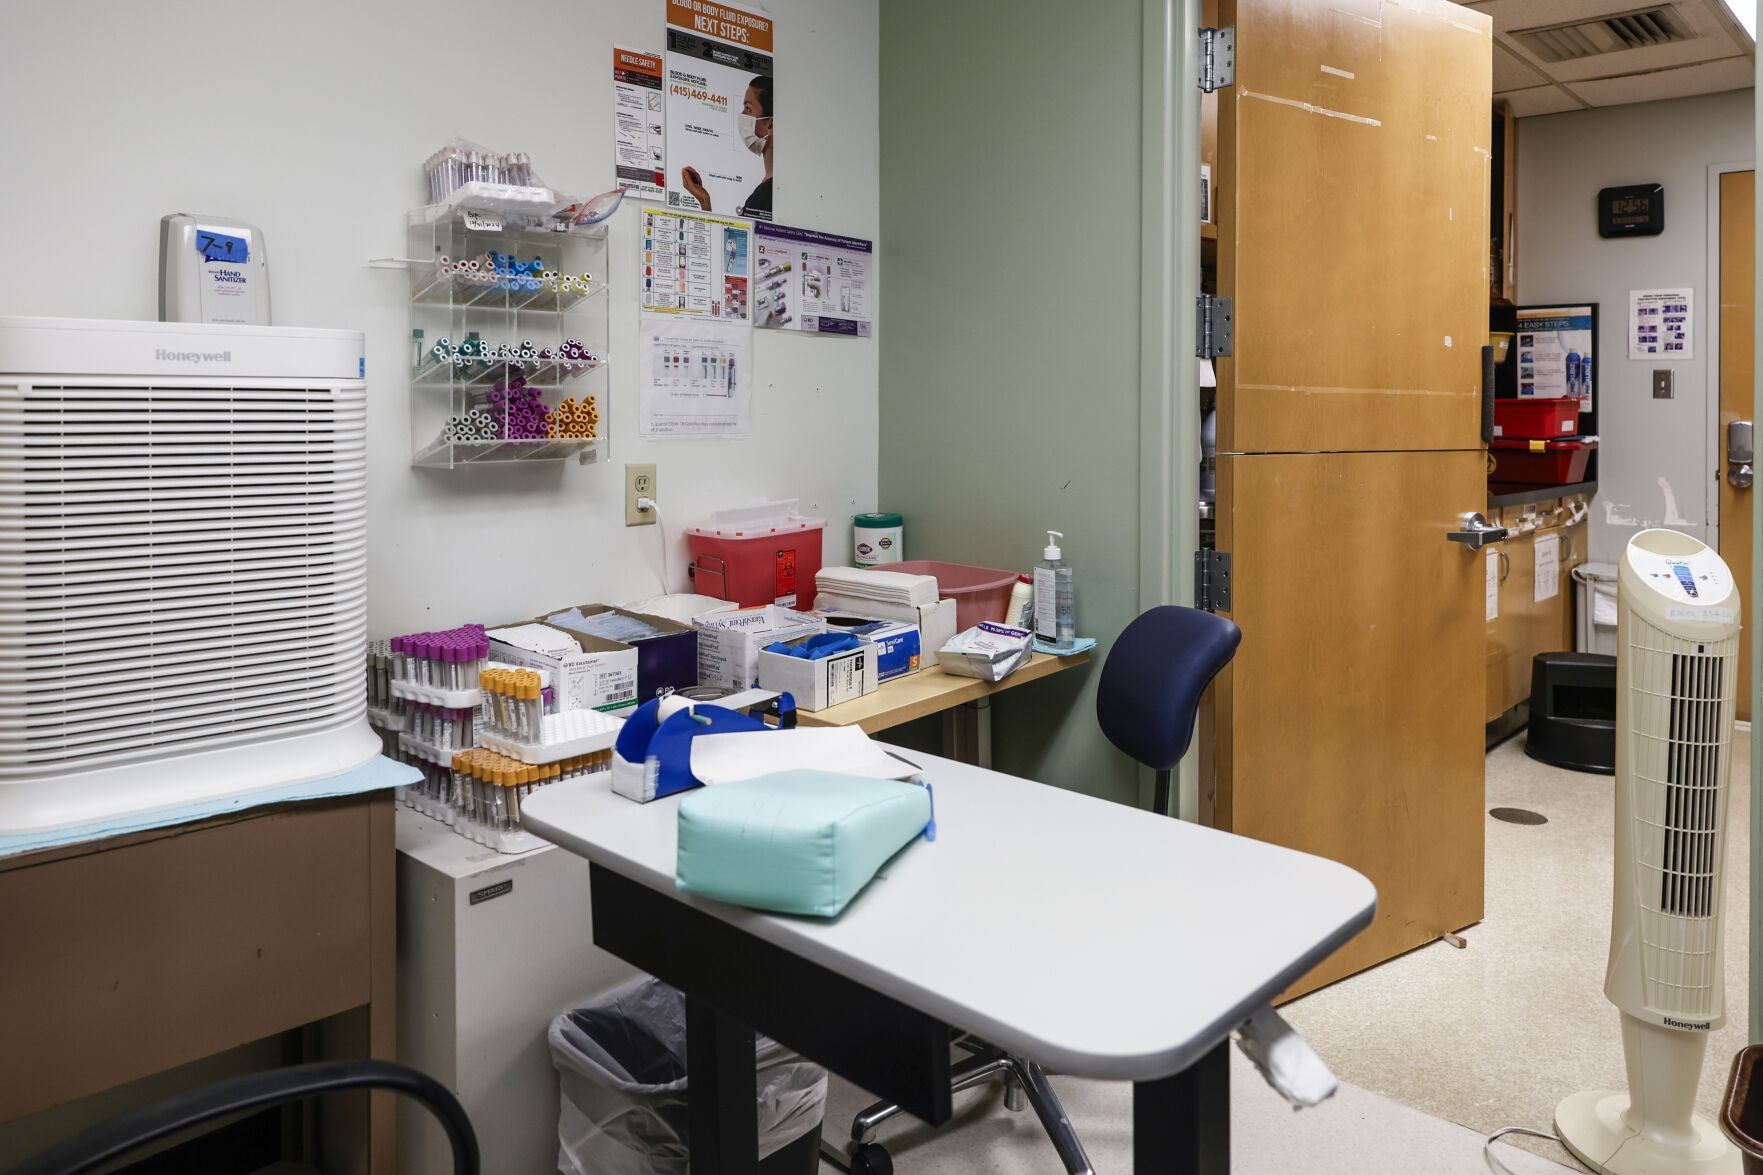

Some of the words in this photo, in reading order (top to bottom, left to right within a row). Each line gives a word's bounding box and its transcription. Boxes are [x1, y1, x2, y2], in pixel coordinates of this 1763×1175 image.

[693, 2, 702, 12] OR
[702, 5, 718, 17] BODY
[720, 9, 736, 22] FLUID
[737, 14, 769, 32] EXPOSURE?
[694, 14, 718, 34] NEXT
[720, 22, 750, 44] STEPS:
[702, 41, 713, 59] 2
[620, 54, 639, 65] NEEDLE
[638, 58, 657, 69] SAFETY
[744, 53, 754, 69] 3
[669, 83, 728, 107] (415)469-4411
[214, 274, 247, 284] SANITIZER
[219, 269, 241, 278] HAND
[1524, 321, 1544, 329] EASY
[1544, 320, 1569, 328] STEPS
[155, 349, 232, 364] Honeywell
[912, 656, 918, 667] S
[1663, 1017, 1710, 1031] Honeywell
